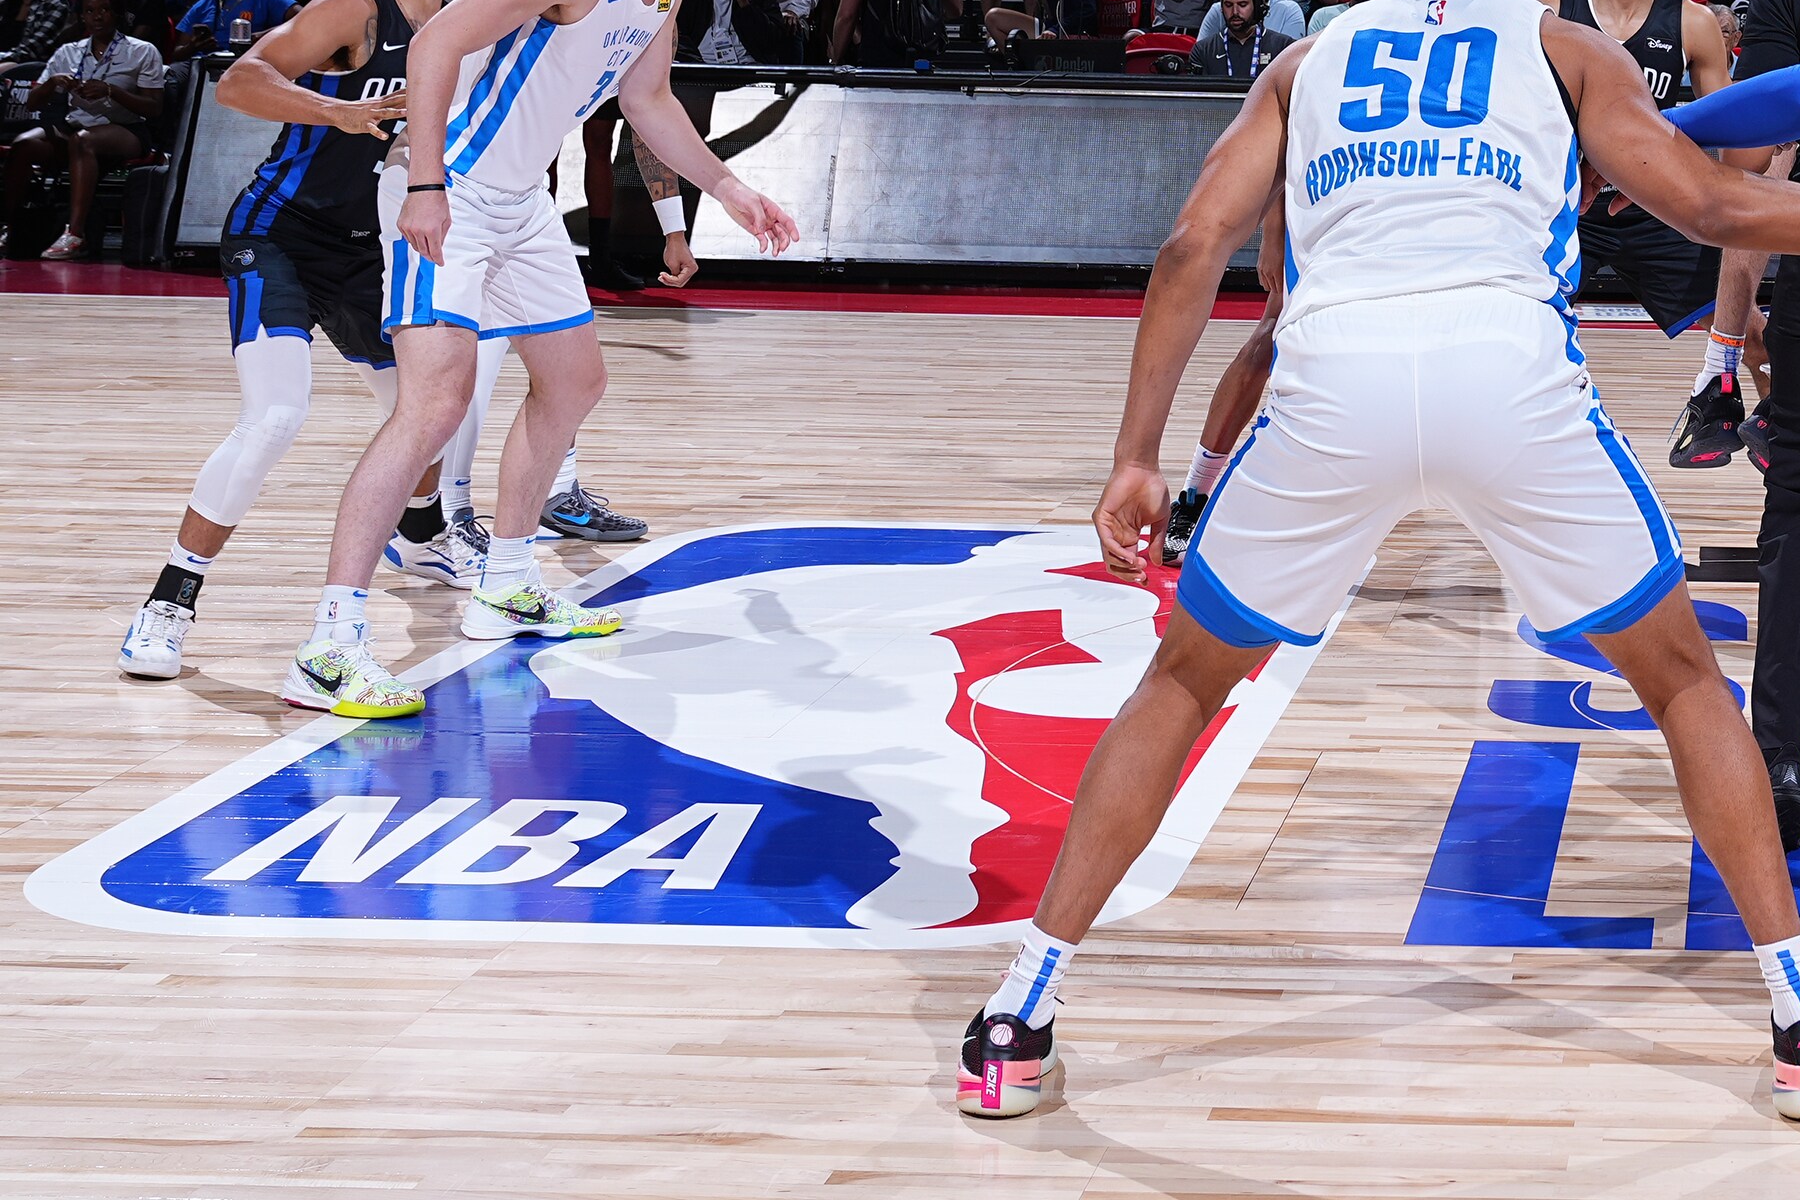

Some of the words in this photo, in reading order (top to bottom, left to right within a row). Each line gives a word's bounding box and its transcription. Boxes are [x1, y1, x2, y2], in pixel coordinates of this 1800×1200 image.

[1339, 27, 1497, 132] 50
[1647, 38, 1673, 52] Disney
[1305, 137, 1523, 206] ROBINSON-EARL
[202, 796, 763, 890] NBA
